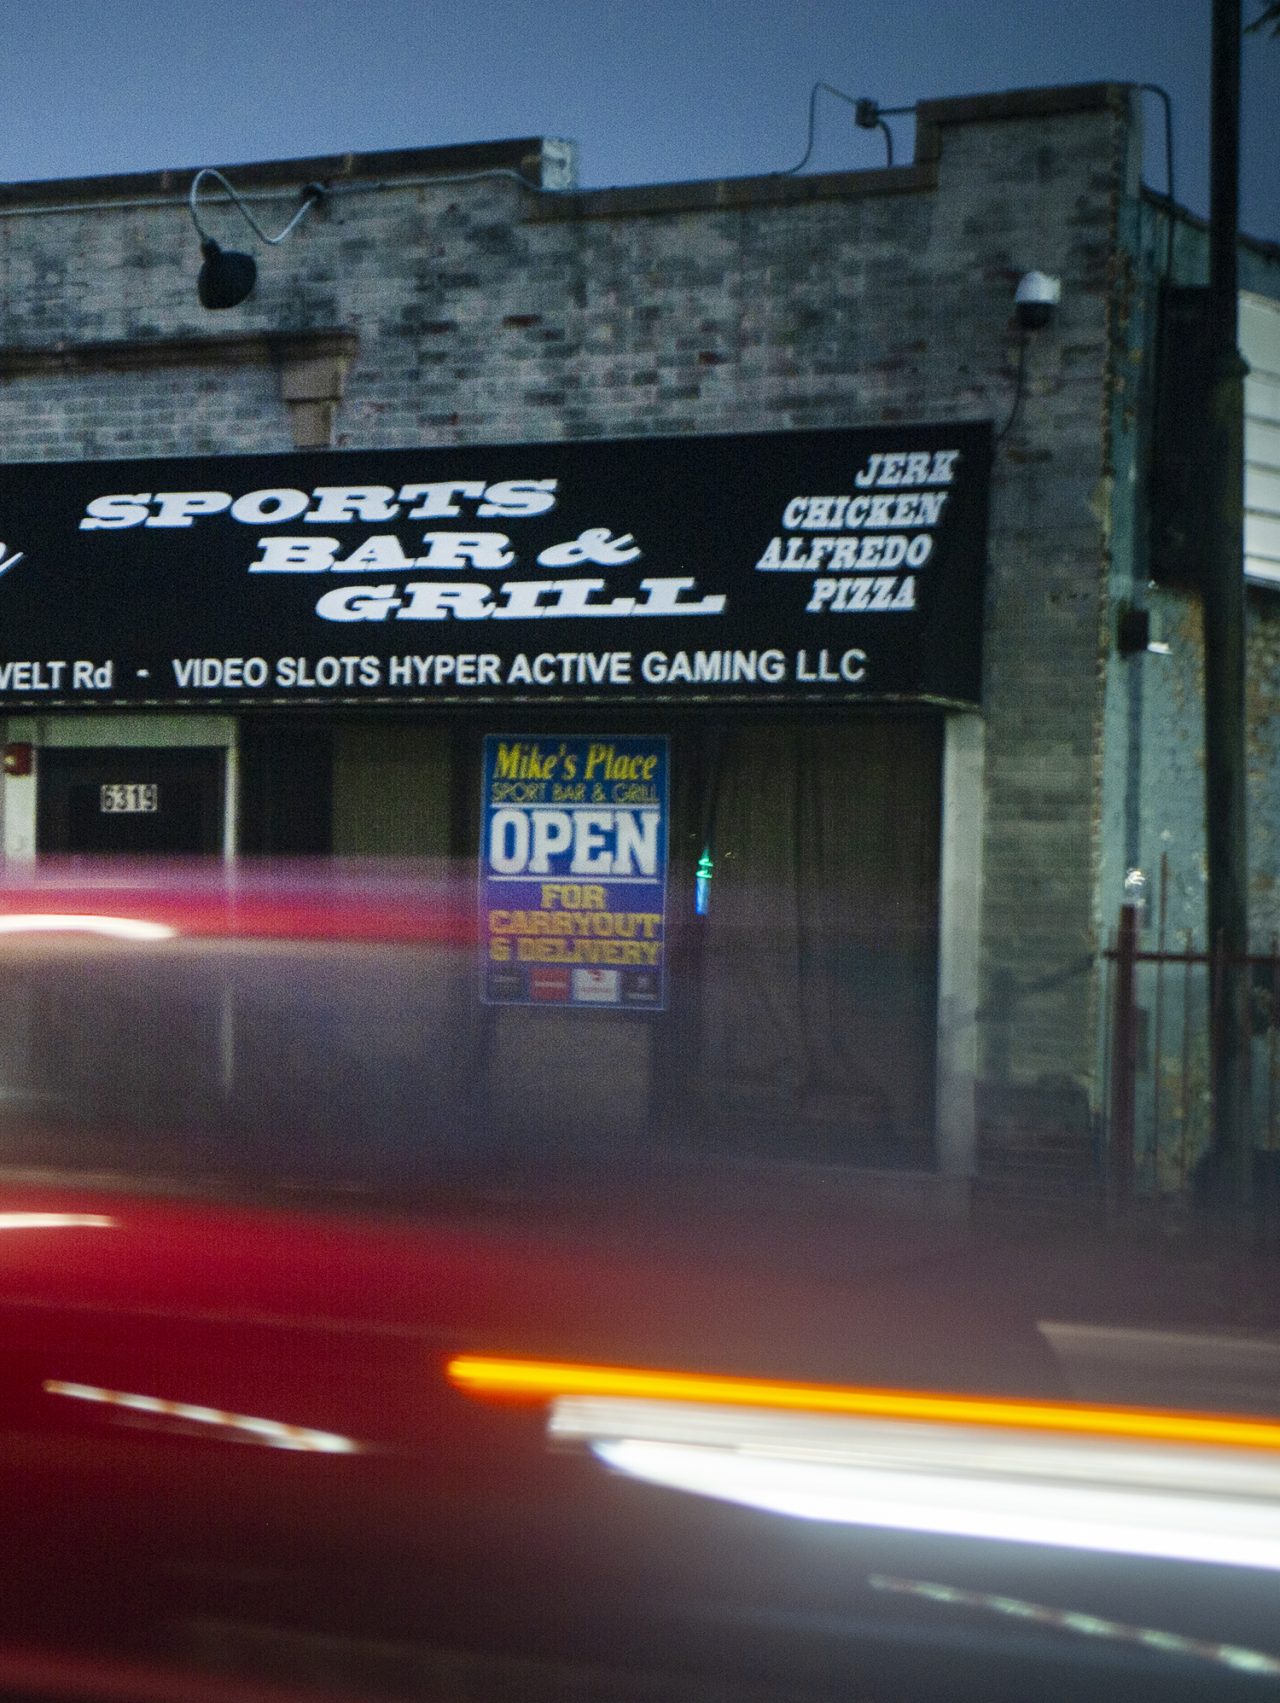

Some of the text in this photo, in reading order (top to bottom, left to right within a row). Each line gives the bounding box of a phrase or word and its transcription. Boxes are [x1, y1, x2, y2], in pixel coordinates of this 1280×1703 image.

[855, 451, 958, 488] JERK
[79, 479, 557, 530] SPORTS
[782, 492, 947, 531] CHICKEN
[248, 528, 641, 573] BAR &
[755, 534, 932, 572] ALFREDO
[315, 577, 726, 623] GRILL
[805, 576, 915, 613] PIZZA
[73, 660, 113, 689] Rd
[172, 657, 268, 688] VIDEO
[276, 656, 381, 687] SLOTS
[389, 654, 501, 685] HYPER
[506, 652, 632, 685] ACTIVE
[641, 652, 785, 684] GAMING
[796, 649, 866, 682] LLC
[493, 742, 657, 780] Mike's Place
[101, 784, 157, 812] 6319
[491, 782, 657, 803] SPORT BAR & GRILL
[489, 808, 660, 875] OPEN
[540, 884, 607, 910] FOR
[488, 909, 661, 938] CARRYOUT
[517, 936, 661, 965] DELIVERY
